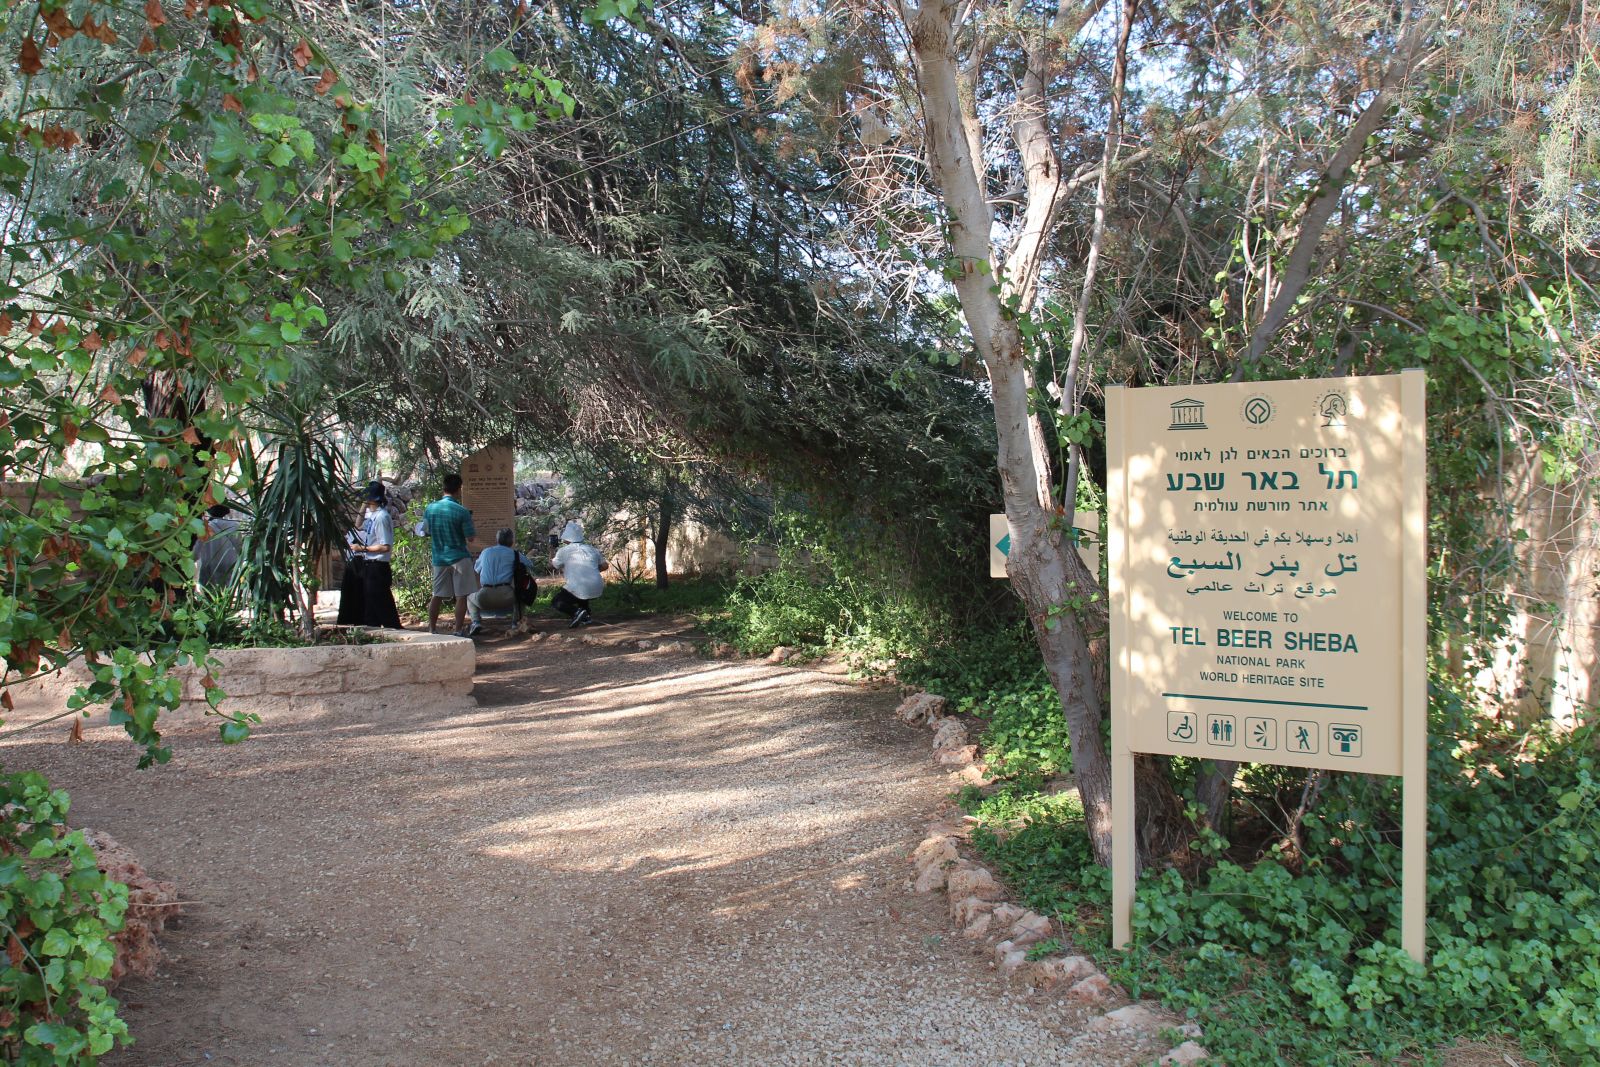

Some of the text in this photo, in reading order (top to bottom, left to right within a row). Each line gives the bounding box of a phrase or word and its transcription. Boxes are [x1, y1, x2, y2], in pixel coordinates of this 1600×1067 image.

[1171, 408, 1204, 423] UNESCO
[1176, 446, 1347, 463] ברוכים הבאים לגן לאומי
[1167, 463, 1358, 491] תל באר שבע
[1194, 499, 1328, 511] אתר מורשת עולמית
[1223, 611, 1298, 623] WELCOME TO
[1169, 627, 1358, 653] TEL BEER SHEBA
[1217, 655, 1305, 669] NATIONAL PARK
[1200, 672, 1324, 688] WORLD HERITAGE SITE
